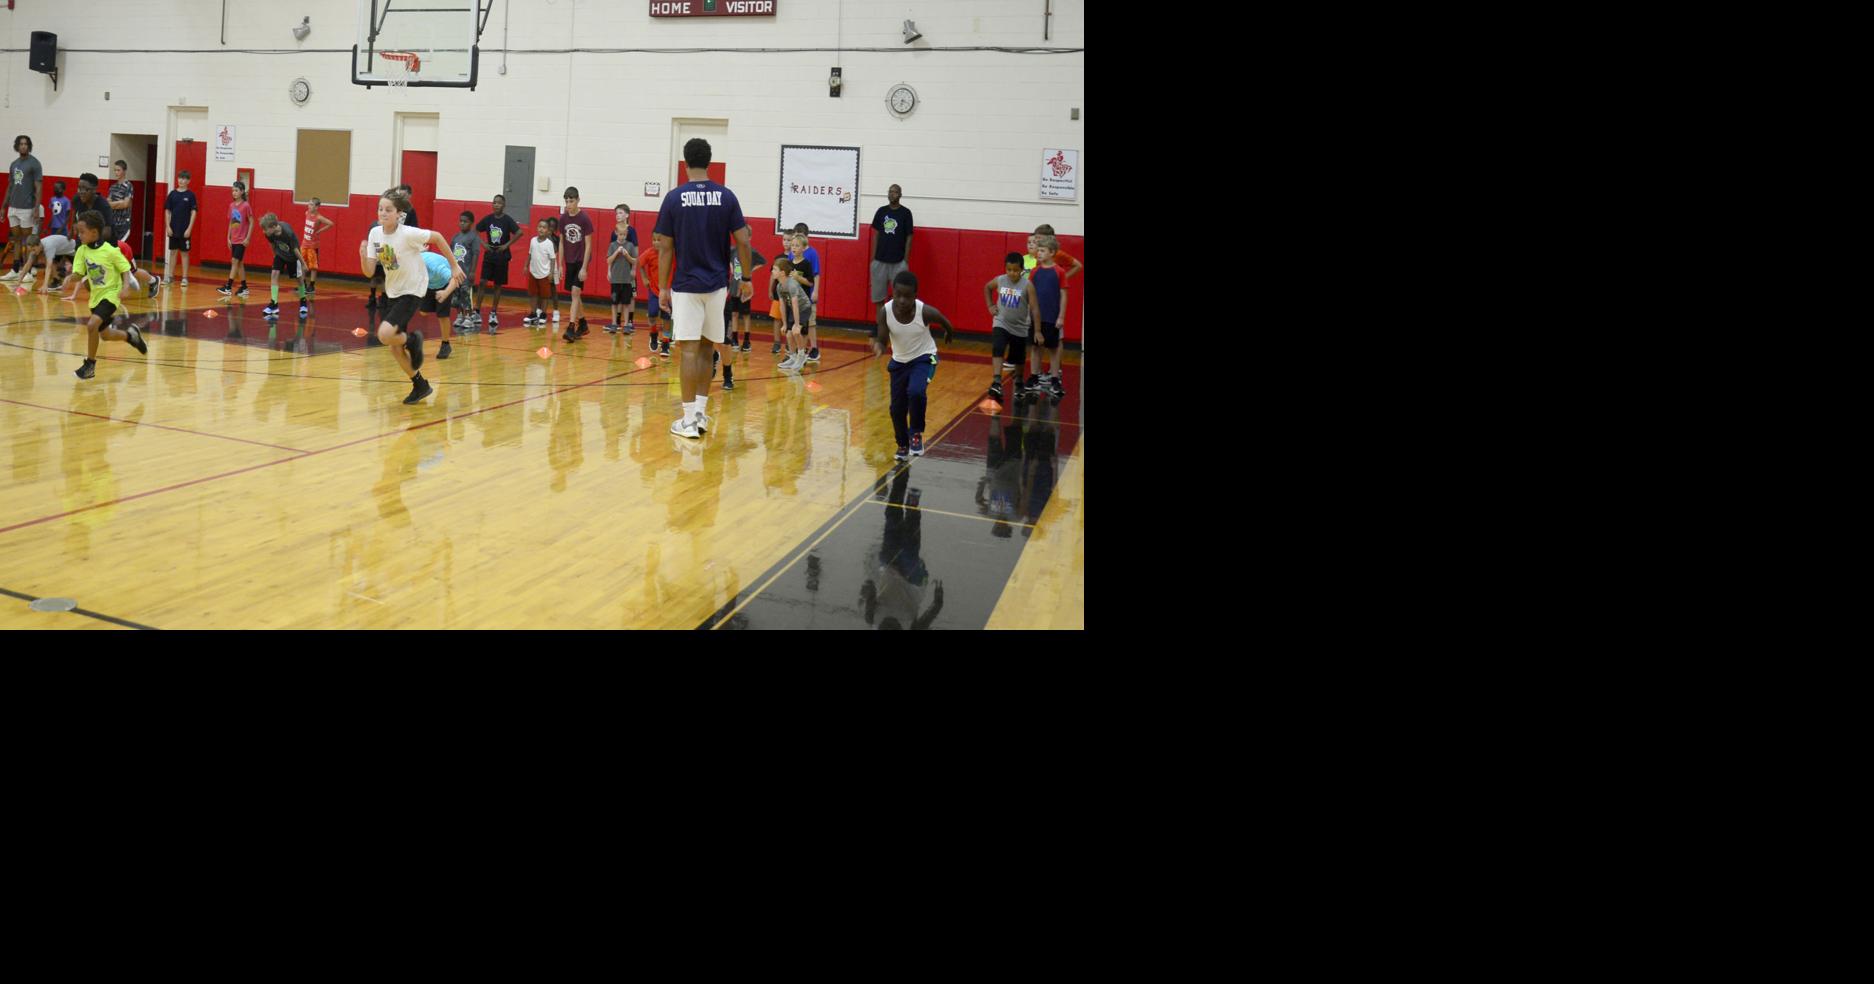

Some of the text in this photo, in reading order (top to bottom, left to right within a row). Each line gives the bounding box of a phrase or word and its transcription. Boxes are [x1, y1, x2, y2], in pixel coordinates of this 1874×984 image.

[651, 2, 691, 14] HOME
[726, 1, 773, 13] VISITOR
[793, 184, 842, 196] RAIDERS
[681, 191, 722, 207] SQUAT DAY
[1001, 293, 1020, 308] WIN
